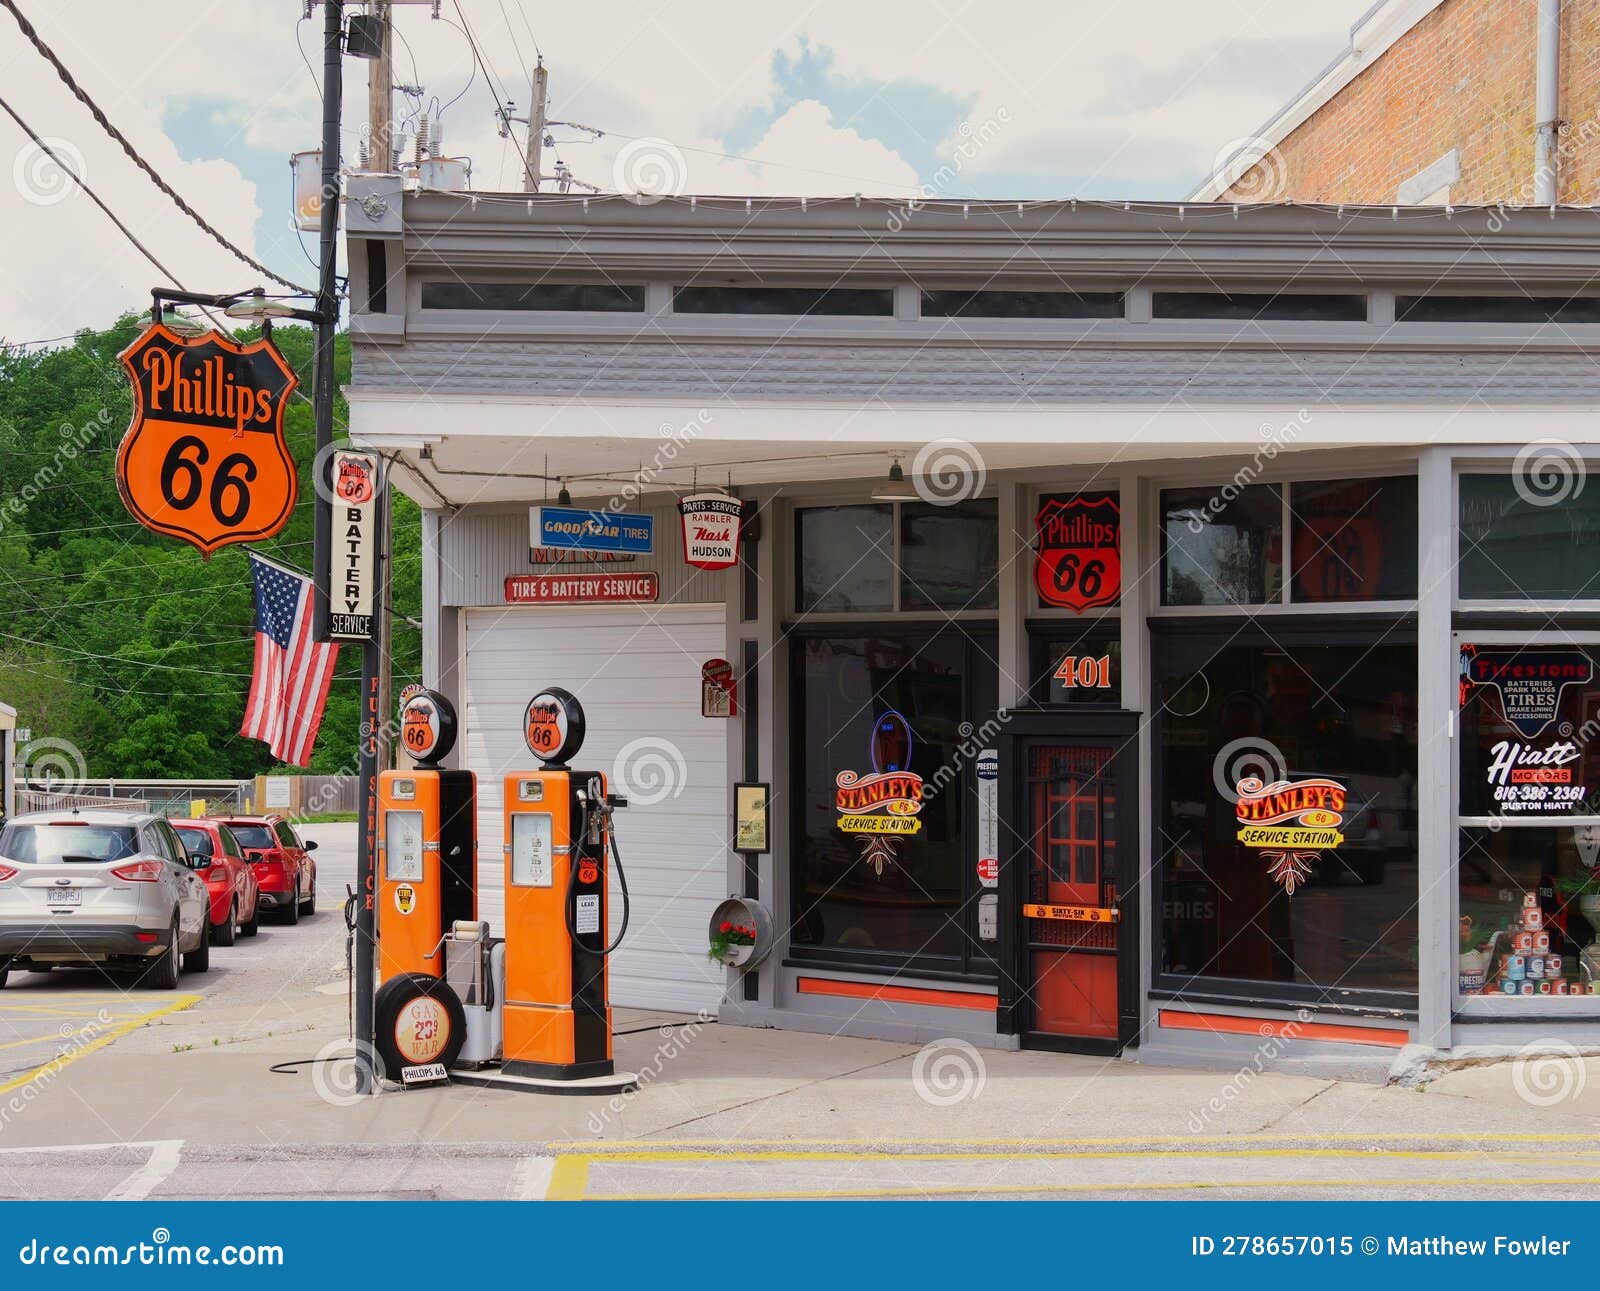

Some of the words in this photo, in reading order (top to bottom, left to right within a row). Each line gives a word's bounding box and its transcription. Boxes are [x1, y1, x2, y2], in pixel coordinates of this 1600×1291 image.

[143, 346, 272, 438] Phillips
[340, 460, 369, 480] Phillips
[161, 435, 257, 527] 66
[345, 480, 364, 498] 66
[683, 502, 706, 512] PARTS
[712, 502, 741, 516] SERVICE
[692, 514, 732, 524] RAMBLER
[544, 519, 620, 538] GOODYEAR
[623, 526, 649, 540] TIRES
[693, 527, 730, 542] Nash
[1043, 513, 1114, 549] Phillips
[345, 507, 362, 614] BATTERY
[692, 546, 731, 558] HUDSON
[1053, 554, 1105, 598] 66
[512, 582, 536, 598] TIRE
[540, 582, 549, 597] &
[552, 580, 600, 596] BATTERY
[603, 580, 650, 596] SERVICE
[332, 614, 370, 634] SERVICE
[1054, 654, 1111, 688] 401
[1476, 660, 1588, 679] Firestone
[1508, 694, 1556, 706] TIRES
[531, 708, 556, 724] Phillips
[408, 728, 425, 746] 66
[533, 727, 552, 746] 66
[1488, 740, 1581, 785] Hiatt
[1513, 770, 1569, 780] MOTORS
[836, 778, 924, 810] STANLEY'S
[1494, 786, 1586, 801] 816-386-2361
[1236, 787, 1345, 820] STANLEY'S
[1502, 802, 1542, 810] BURTON
[1544, 802, 1574, 810] HIATT
[842, 818, 877, 830] SERVICE
[880, 819, 916, 830] STATION
[1316, 812, 1326, 824] 66
[1244, 830, 1290, 844] SERVICE
[1293, 832, 1336, 844] STATION
[583, 870, 594, 880] 66
[412, 1004, 439, 1020] GAS
[412, 1040, 440, 1055] WAR
[404, 1067, 433, 1080] PHILLIPS
[436, 1066, 445, 1076] 66
